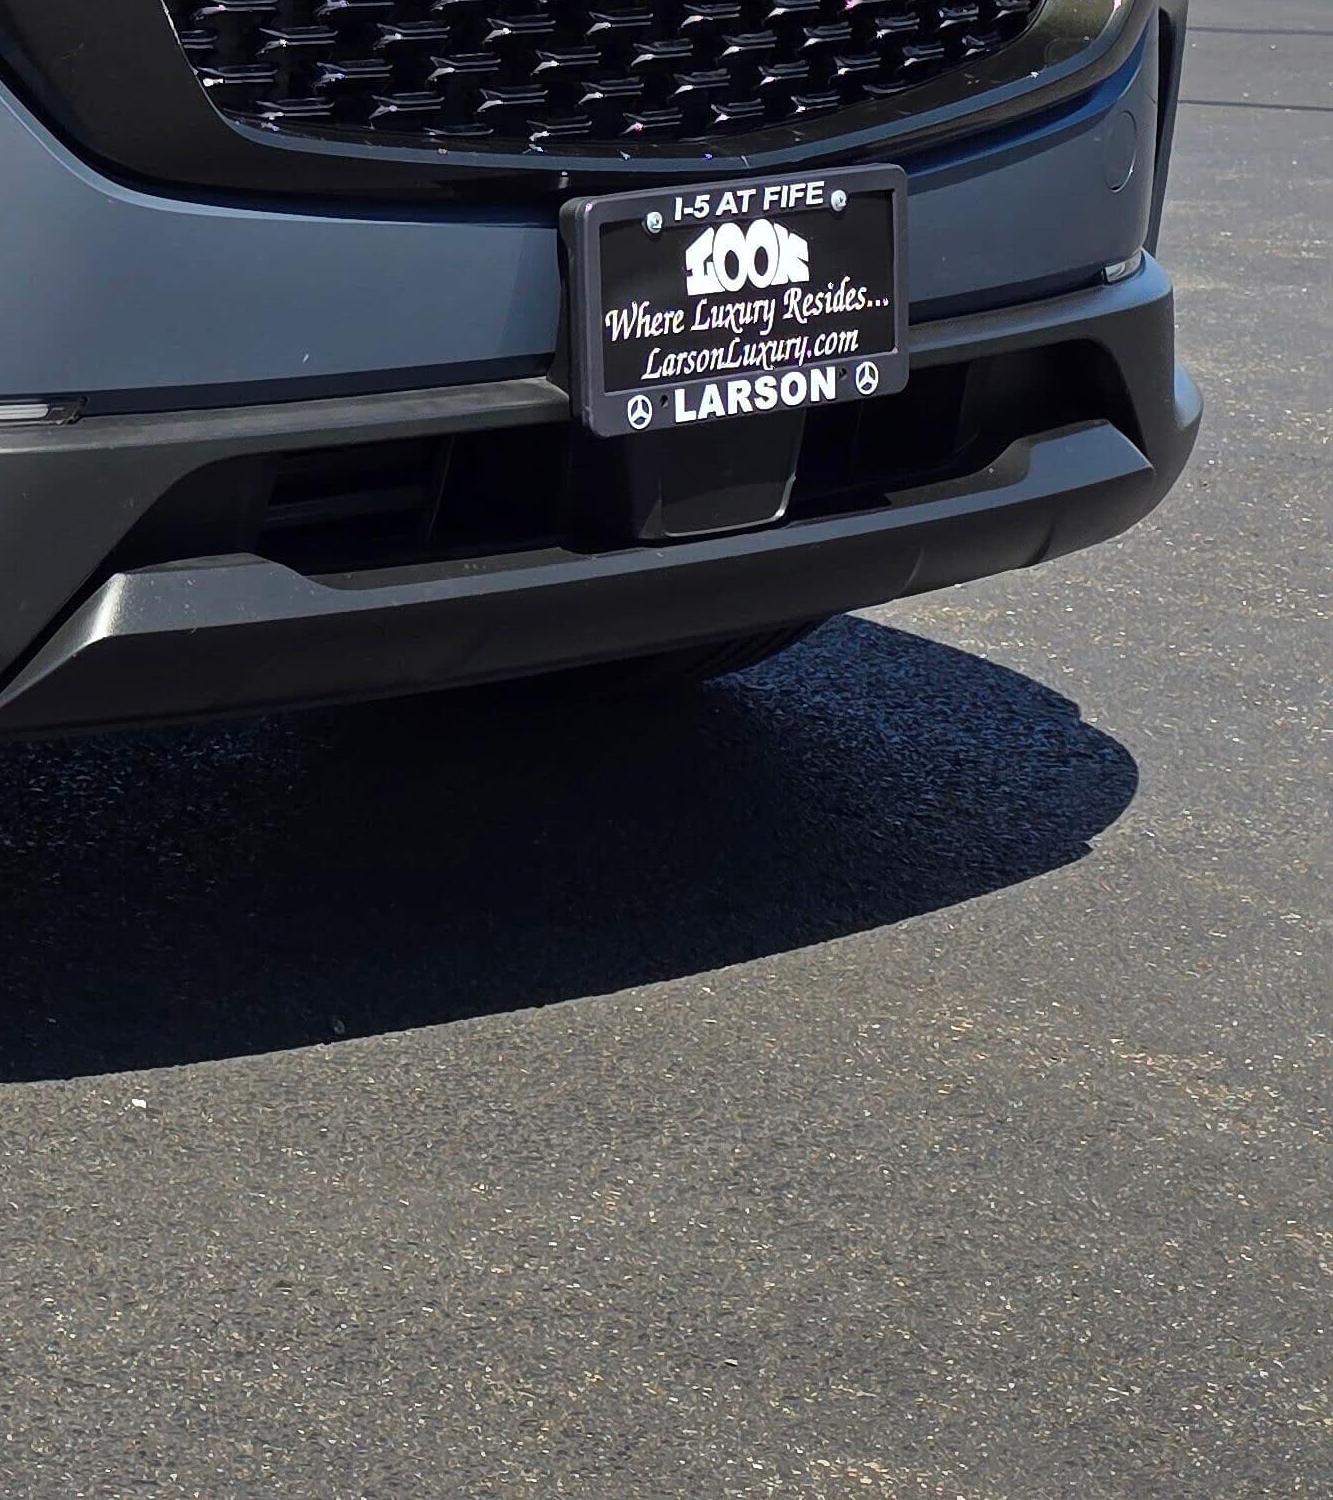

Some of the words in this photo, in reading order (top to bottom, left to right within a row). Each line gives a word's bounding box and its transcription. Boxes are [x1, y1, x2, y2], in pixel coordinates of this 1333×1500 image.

[673, 193, 711, 221] I-5
[715, 189, 756, 215] AT
[762, 181, 826, 210] FIFE
[685, 218, 810, 296] LOOK
[604, 300, 685, 343] Where
[690, 296, 777, 336] Luxury
[782, 275, 890, 324] Resides...
[640, 326, 860, 381] LarsonLuxury.com
[672, 366, 837, 424] LARSON
